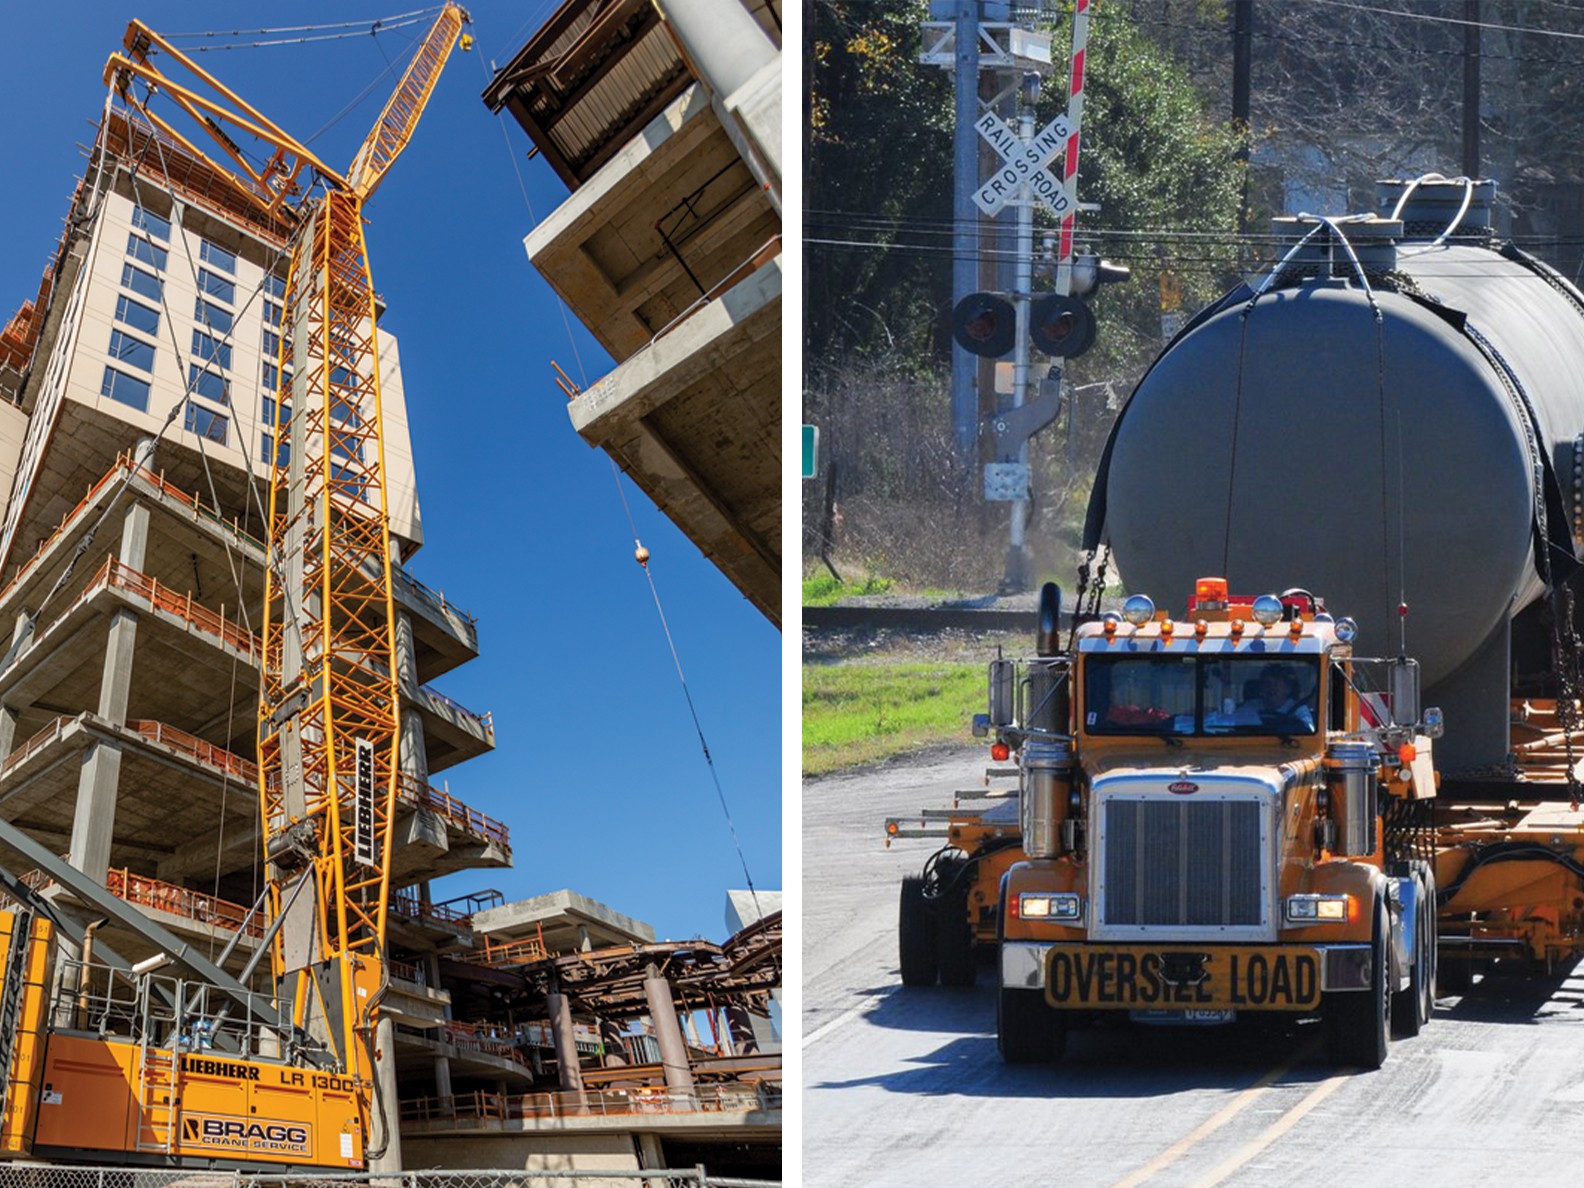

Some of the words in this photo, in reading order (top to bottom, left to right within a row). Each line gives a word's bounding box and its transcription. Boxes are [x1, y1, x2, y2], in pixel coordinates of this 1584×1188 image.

[980, 116, 1015, 157] RAIL
[1029, 170, 1069, 212] ROAD
[981, 123, 1068, 205] CROSSING
[358, 744, 373, 860] LIEBHERR
[1230, 954, 1316, 1004] LOAD
[181, 1058, 260, 1081] LIEBHERR
[280, 1071, 304, 1086] LR
[201, 1136, 249, 1148] CRANE
[253, 1140, 307, 1153] SERVICE
[203, 1119, 307, 1144] BRAGG
